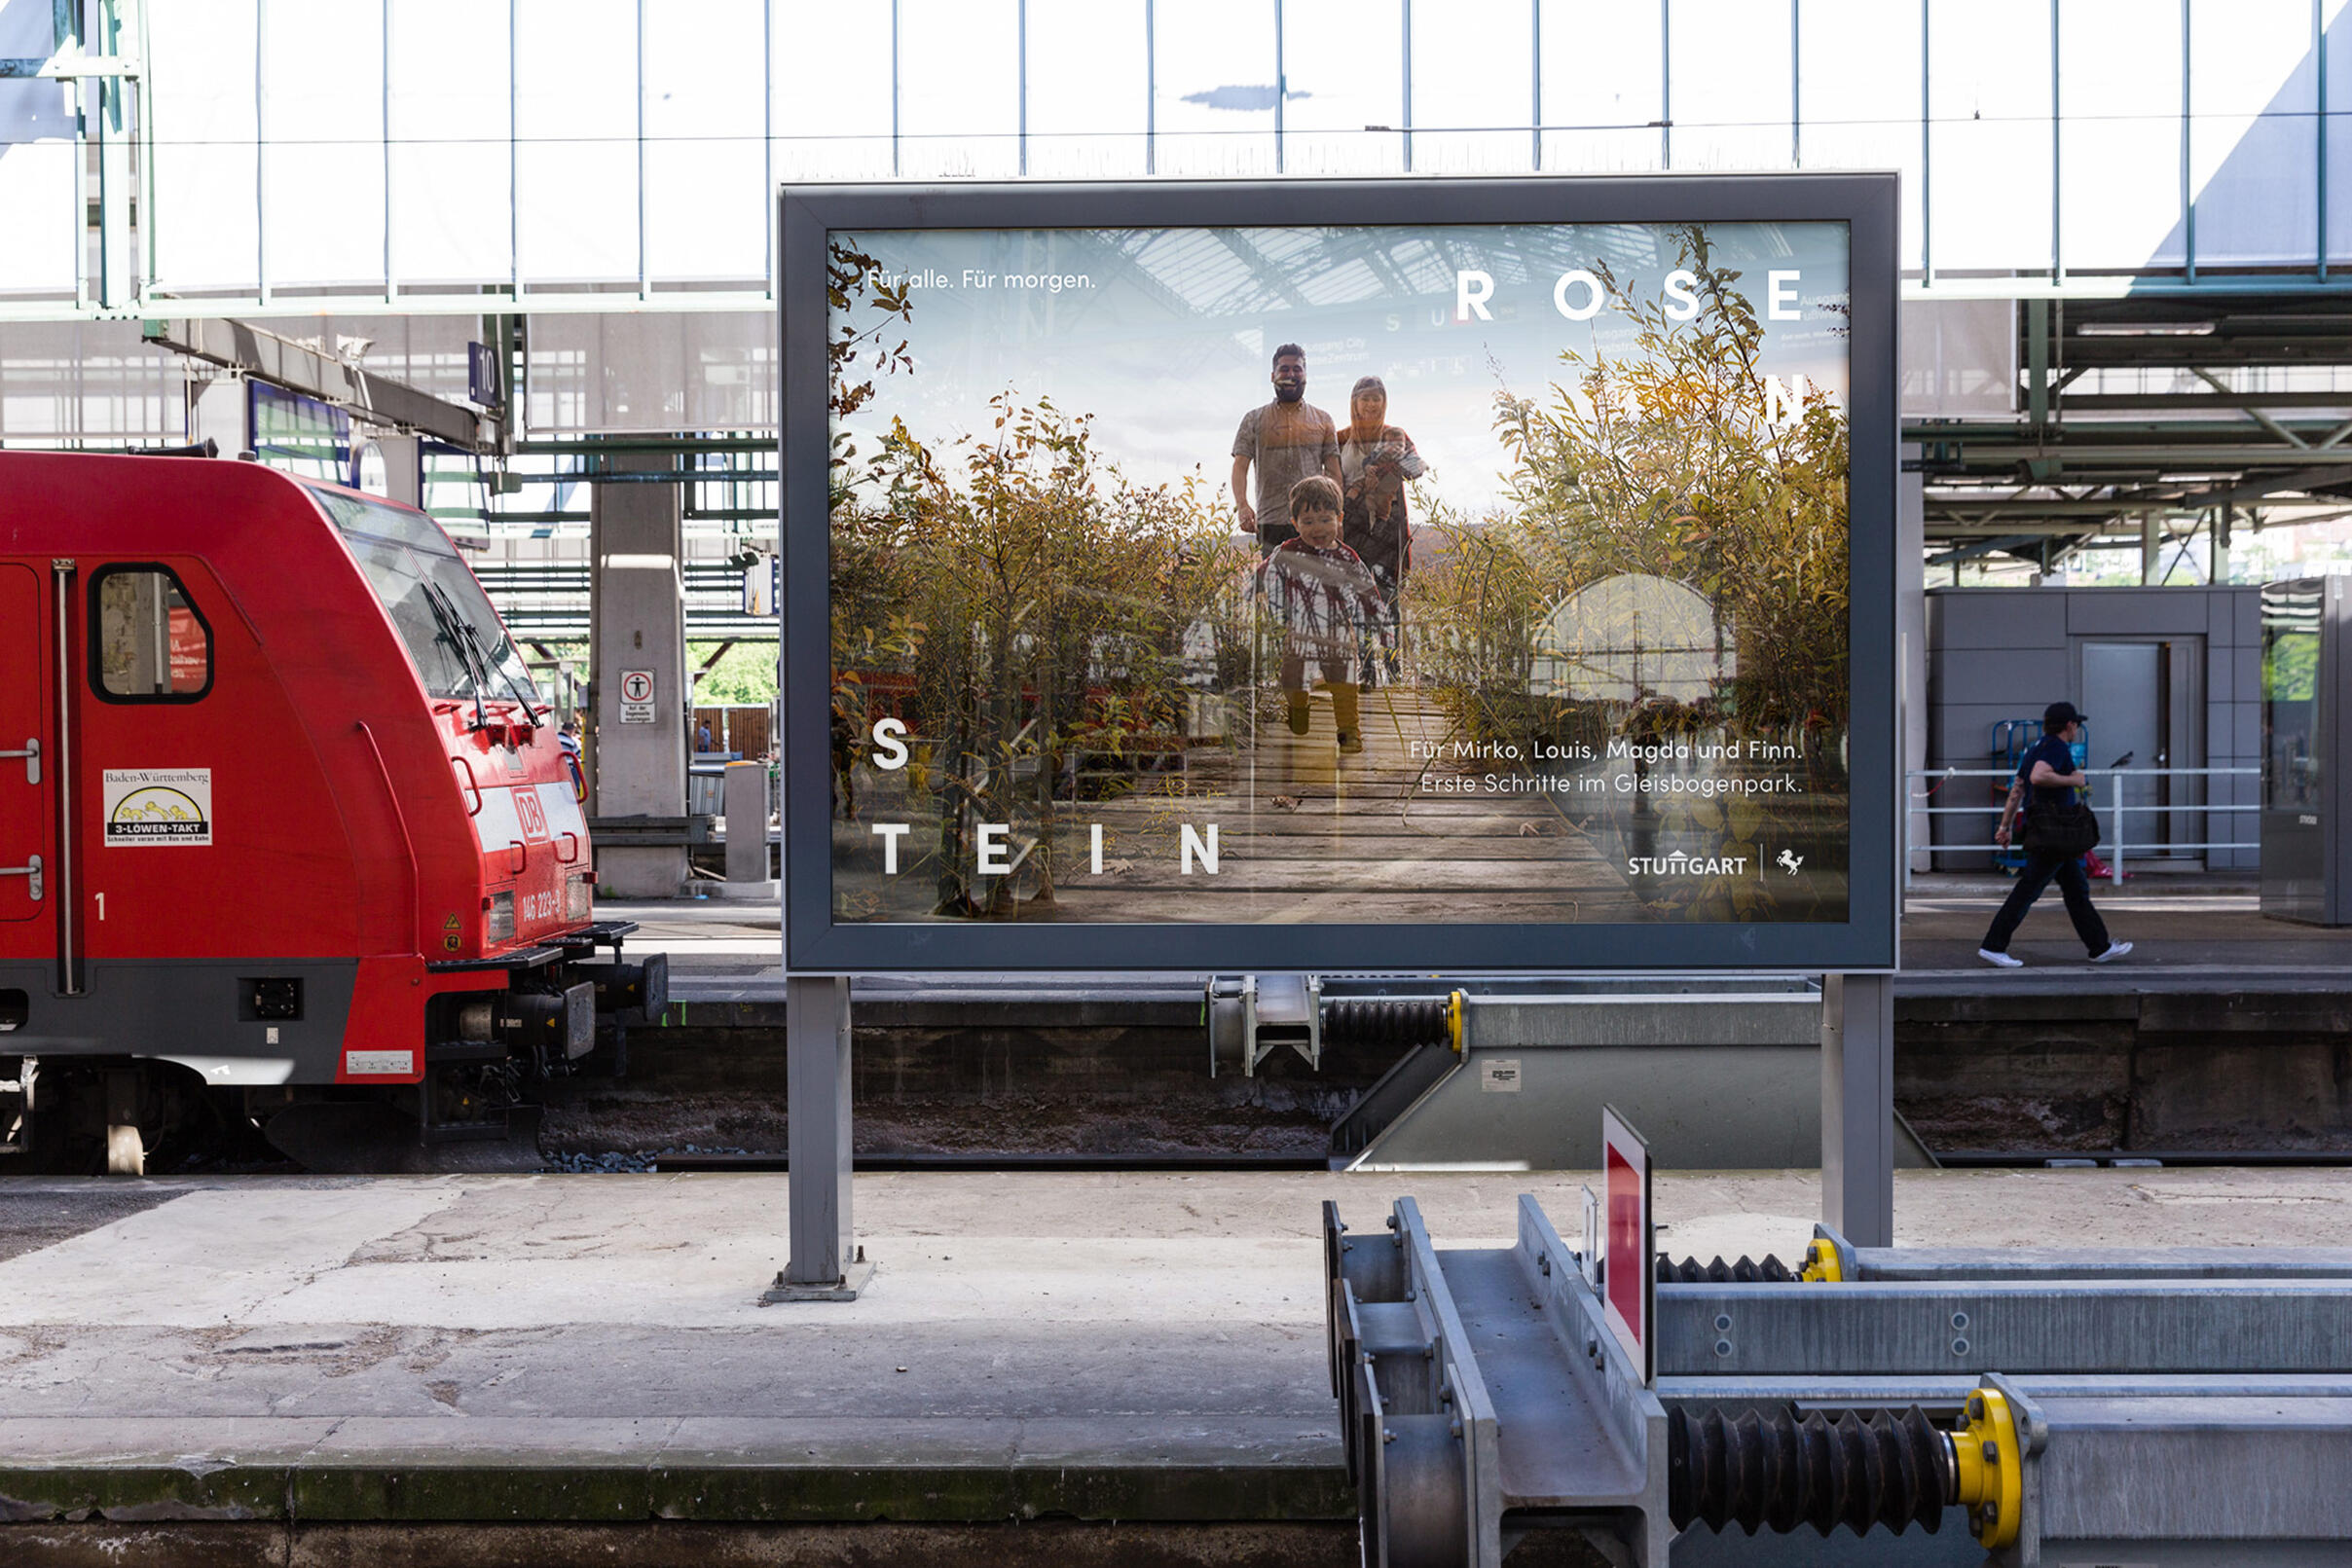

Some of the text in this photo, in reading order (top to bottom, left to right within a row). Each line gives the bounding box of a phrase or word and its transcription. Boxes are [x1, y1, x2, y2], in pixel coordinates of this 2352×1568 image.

[867, 269, 1096, 293] Für alle. Für morgen.
[478, 347, 496, 394] 10
[871, 717, 909, 771] S
[1411, 740, 1802, 764] Für Mirko, Louis, Magda und Finn.
[105, 772, 209, 784] Baden-Württemberg
[1421, 773, 1802, 798] Erste Schritte im Gleisbogenpark.
[518, 795, 544, 835] DB
[115, 823, 201, 834] 3-LÖWEN-TAKT
[871, 823, 1219, 874] TEIN
[1628, 849, 1747, 875] STUTTGART
[94, 892, 105, 922] 1
